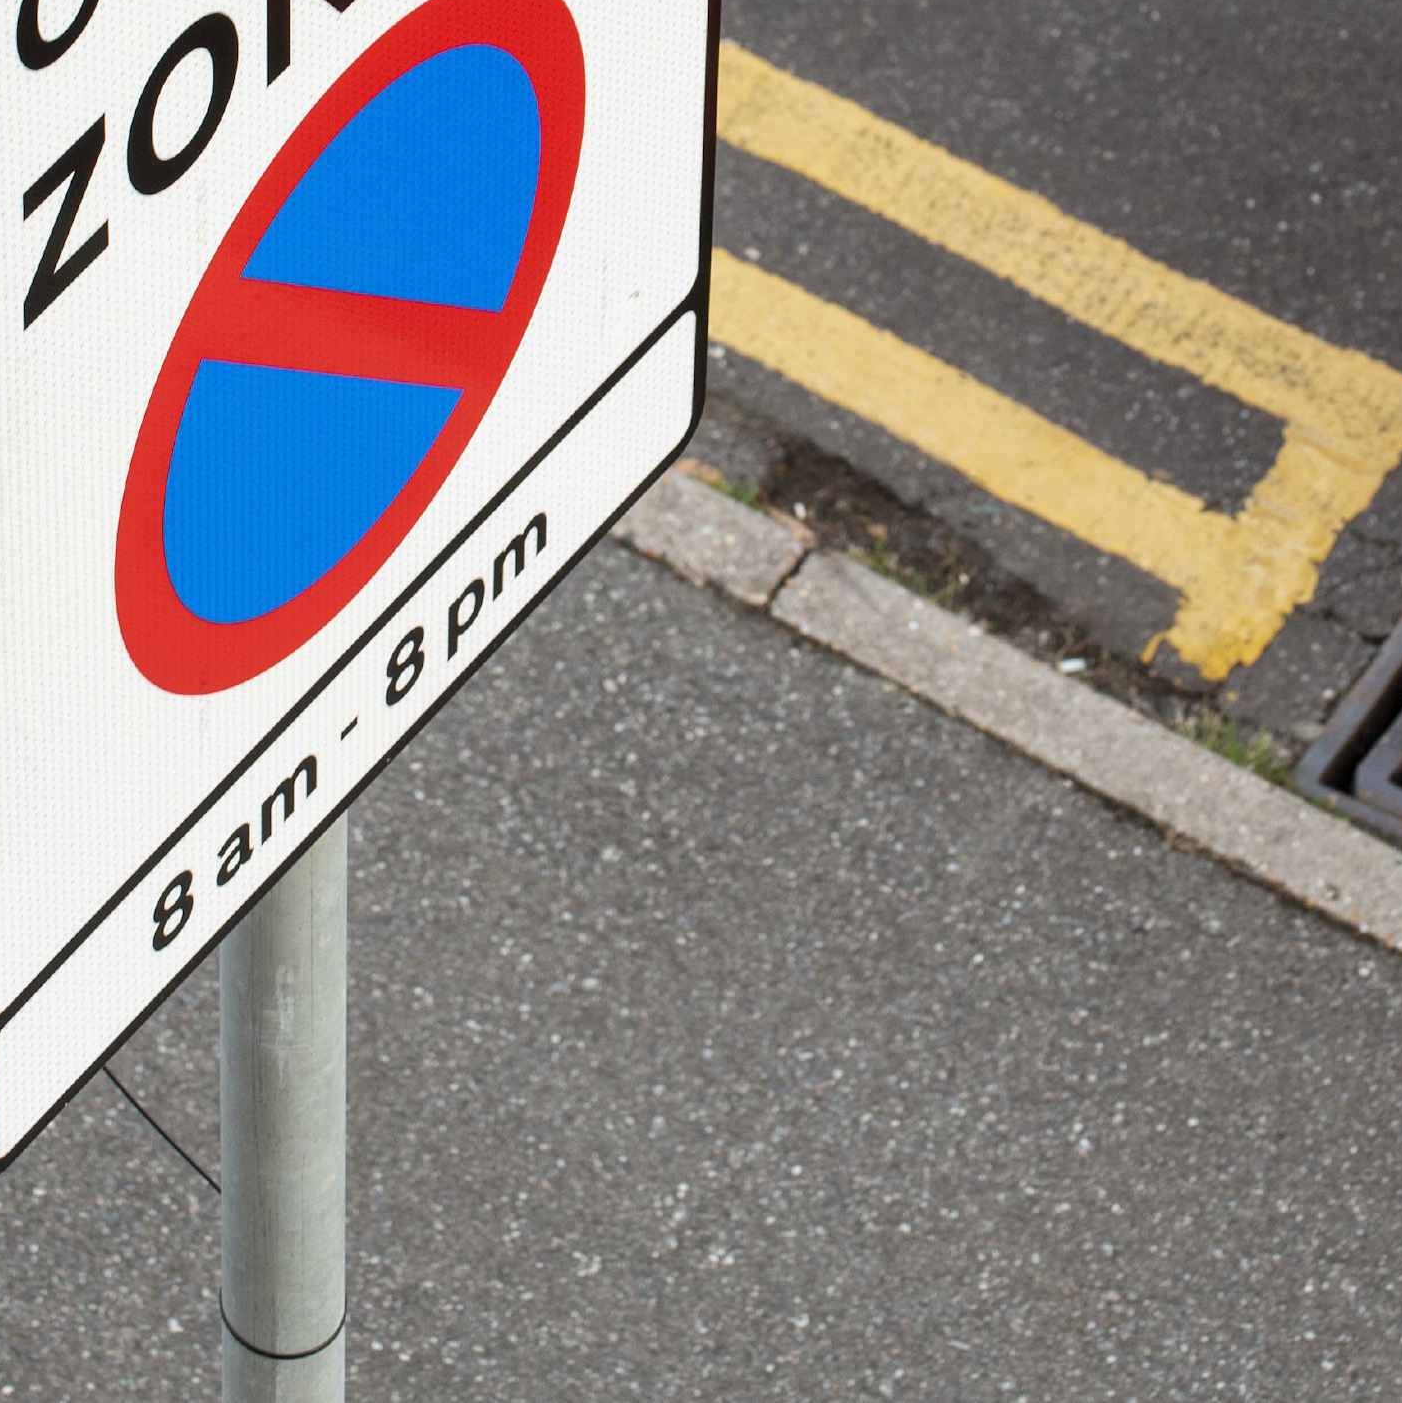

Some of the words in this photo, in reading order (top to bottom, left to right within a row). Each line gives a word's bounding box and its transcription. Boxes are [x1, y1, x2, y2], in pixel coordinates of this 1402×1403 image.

[152, 869, 194, 952] 8
[216, 755, 318, 887] am
[341, 717, 359, 742] -
[385, 625, 425, 707] 8
[447, 512, 547, 662] pm
